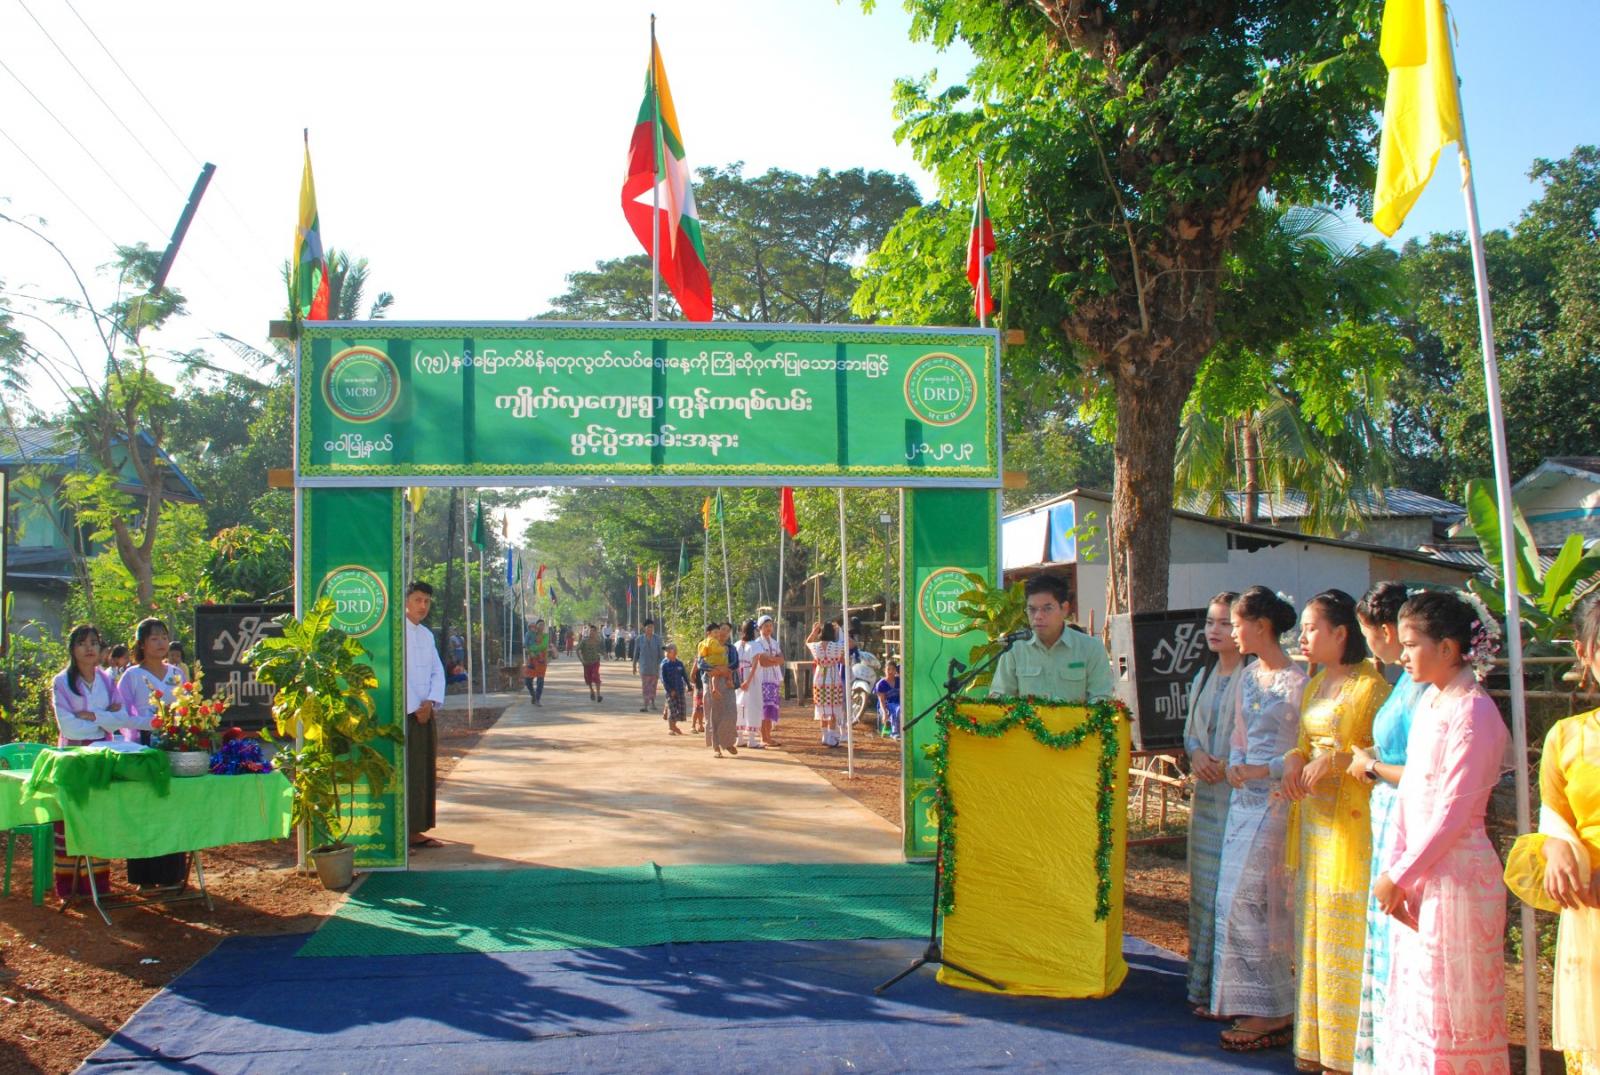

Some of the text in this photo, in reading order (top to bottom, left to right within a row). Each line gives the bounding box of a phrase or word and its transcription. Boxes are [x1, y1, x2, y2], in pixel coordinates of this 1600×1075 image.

[345, 387, 377, 397] MCRD
[924, 387, 960, 401] DRD
[335, 599, 371, 613] DRD
